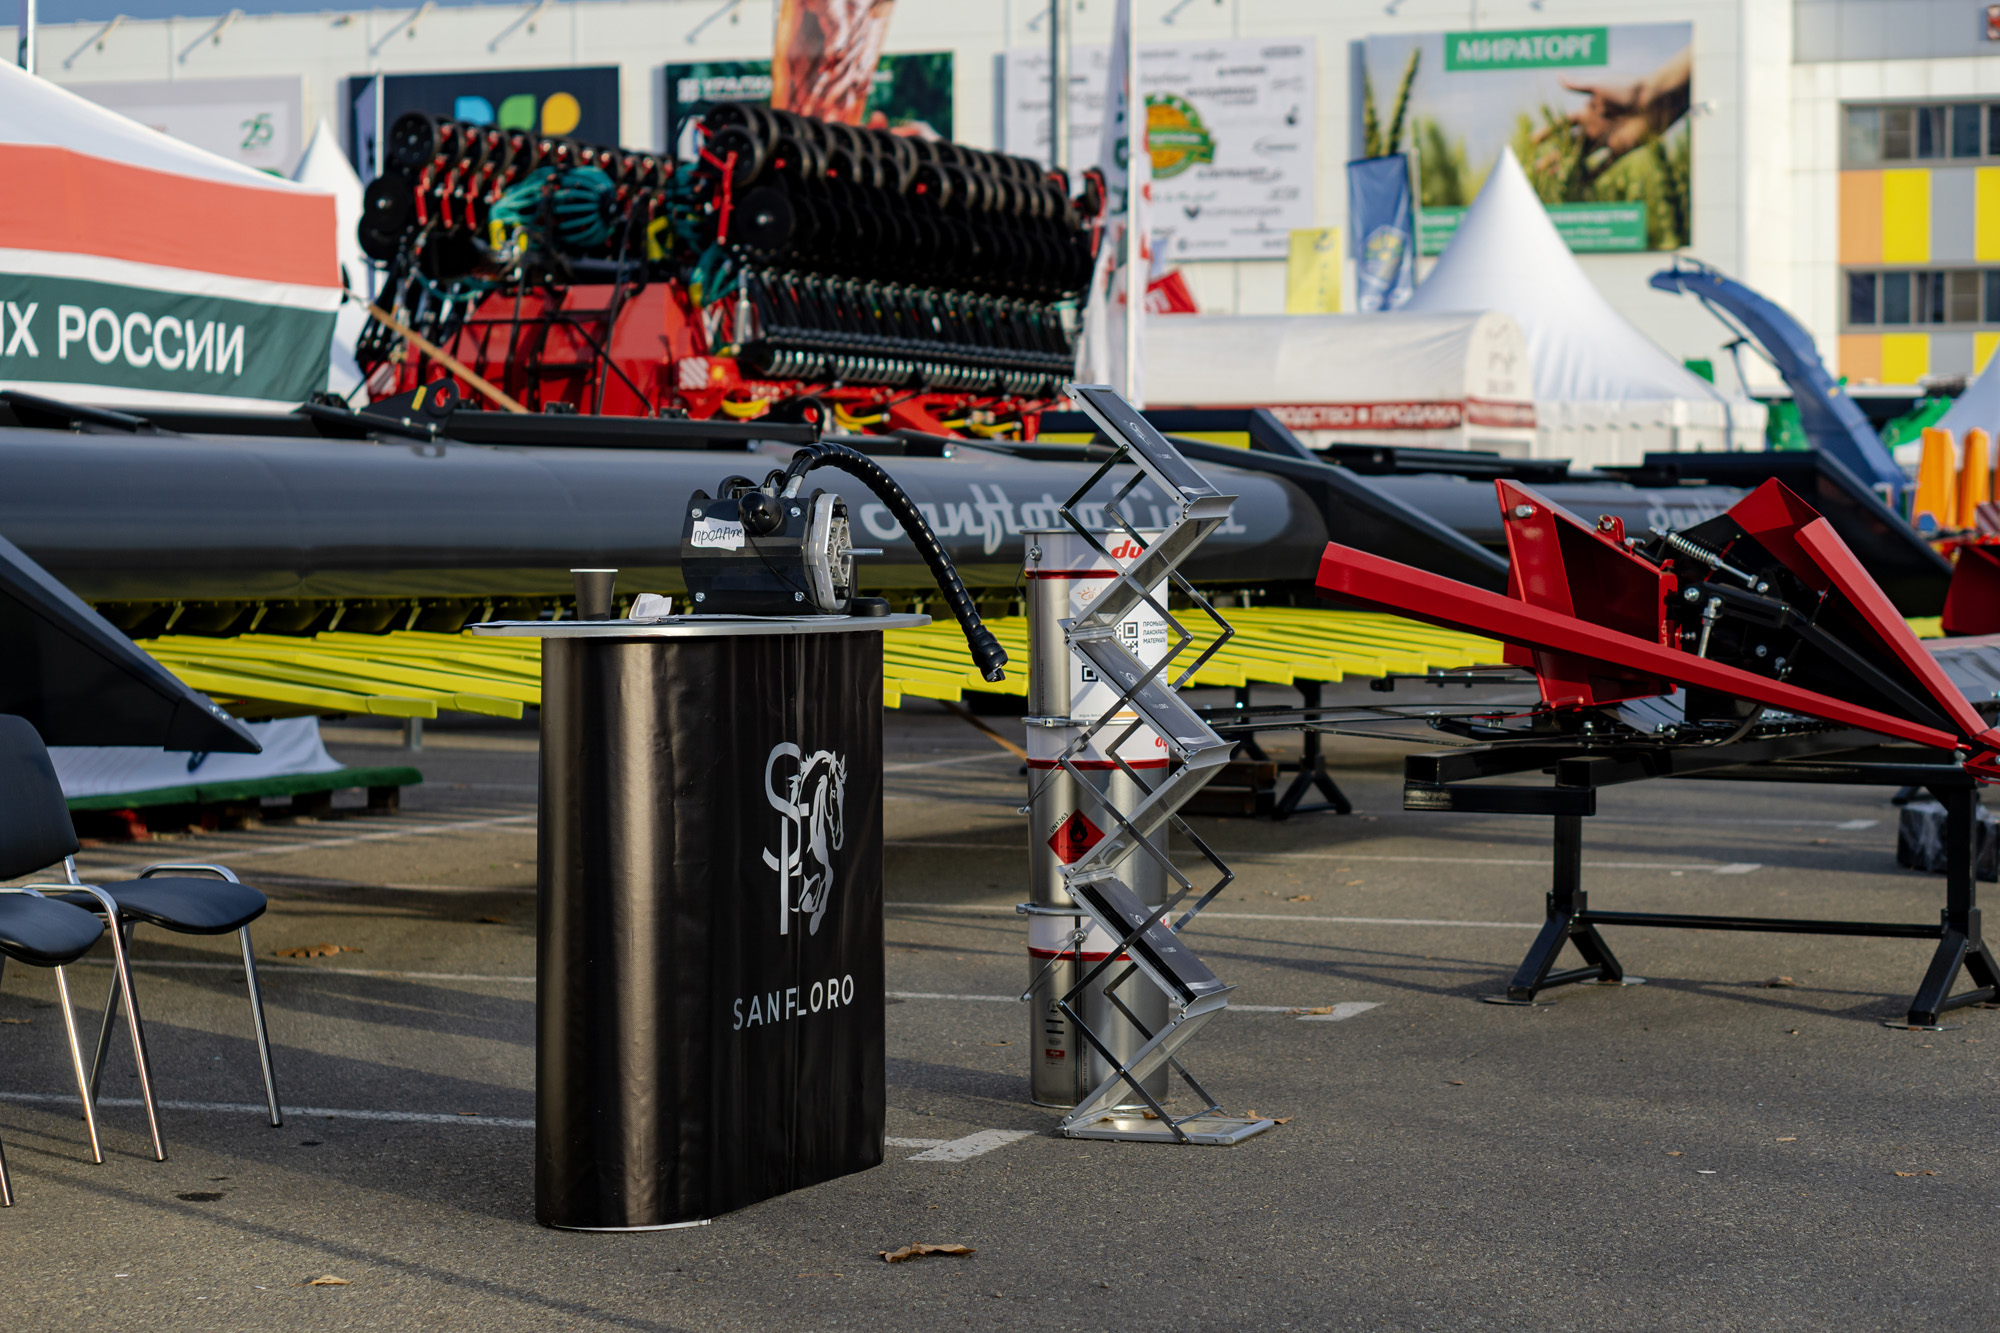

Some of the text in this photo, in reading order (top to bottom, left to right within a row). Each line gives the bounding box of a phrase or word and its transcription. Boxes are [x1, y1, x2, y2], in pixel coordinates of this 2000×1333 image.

[1456, 34, 1596, 63] МИРАТОРГ
[240, 112, 274, 149] 25
[0, 301, 245, 377] Х РОССИИ
[1049, 812, 1069, 834] UN1263
[733, 974, 854, 1031] SANFLORO
